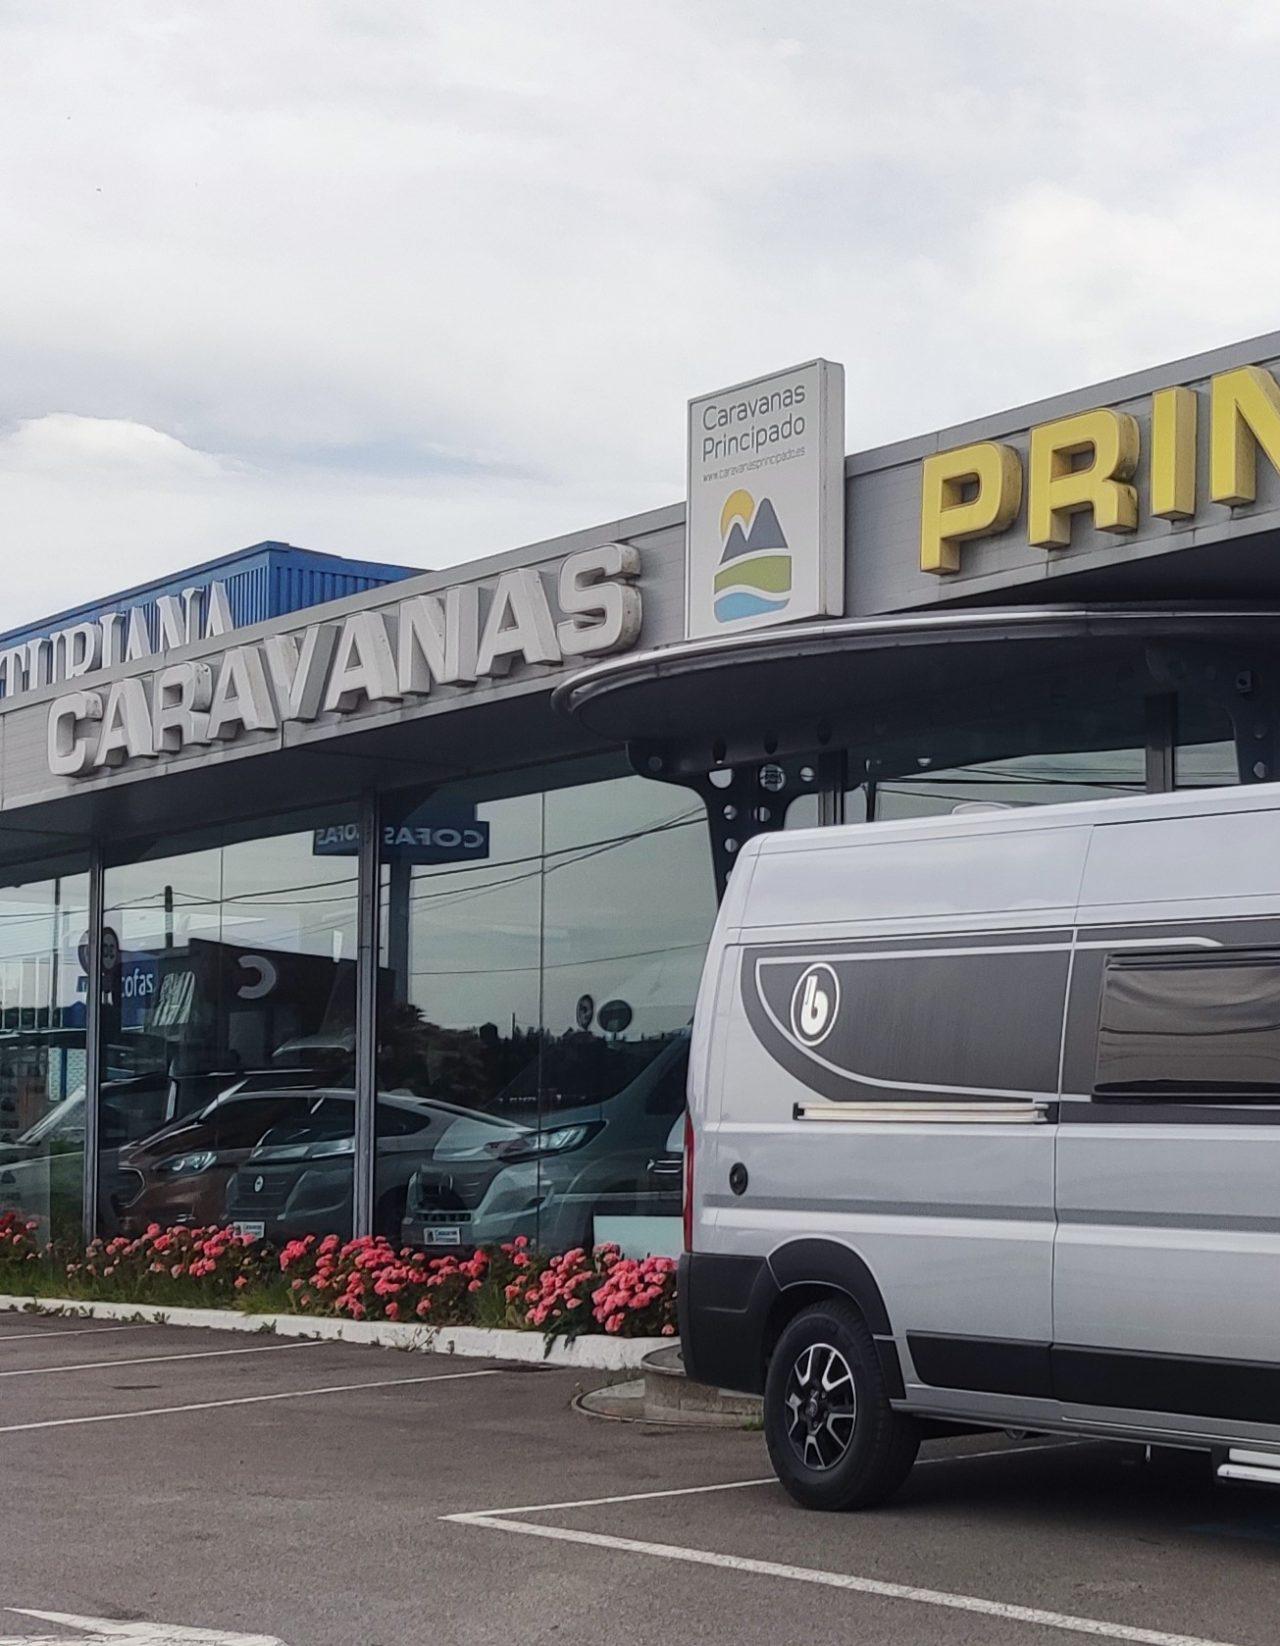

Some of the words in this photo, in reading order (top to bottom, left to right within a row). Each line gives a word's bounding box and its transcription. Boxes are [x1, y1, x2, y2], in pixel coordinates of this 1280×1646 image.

[702, 384, 806, 431] Caravanas
[702, 412, 806, 463] Principado
[47, 542, 642, 777] CARAVANAS
